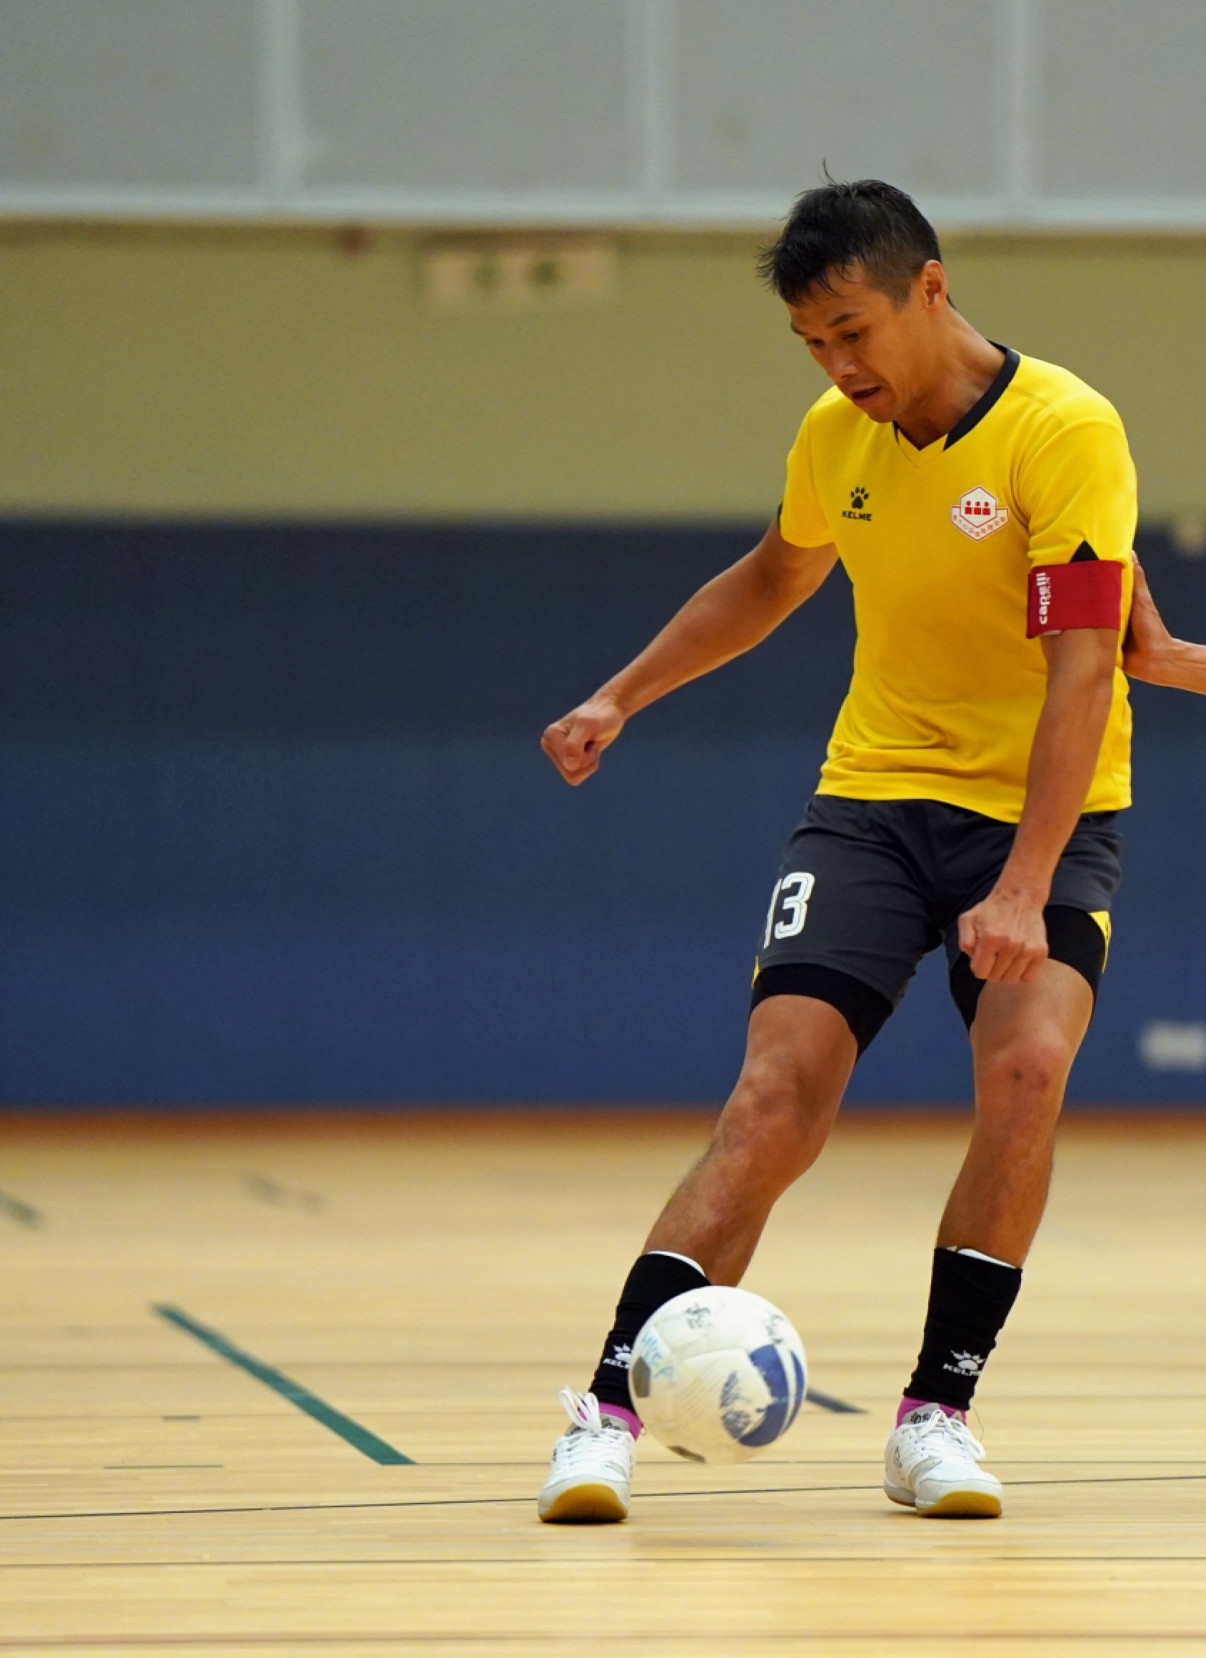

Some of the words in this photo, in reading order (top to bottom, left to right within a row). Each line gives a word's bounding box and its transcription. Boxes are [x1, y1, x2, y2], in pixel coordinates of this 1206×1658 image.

[841, 510, 872, 521] KELME
[1036, 572, 1050, 625] capelli
[763, 872, 815, 949] 13
